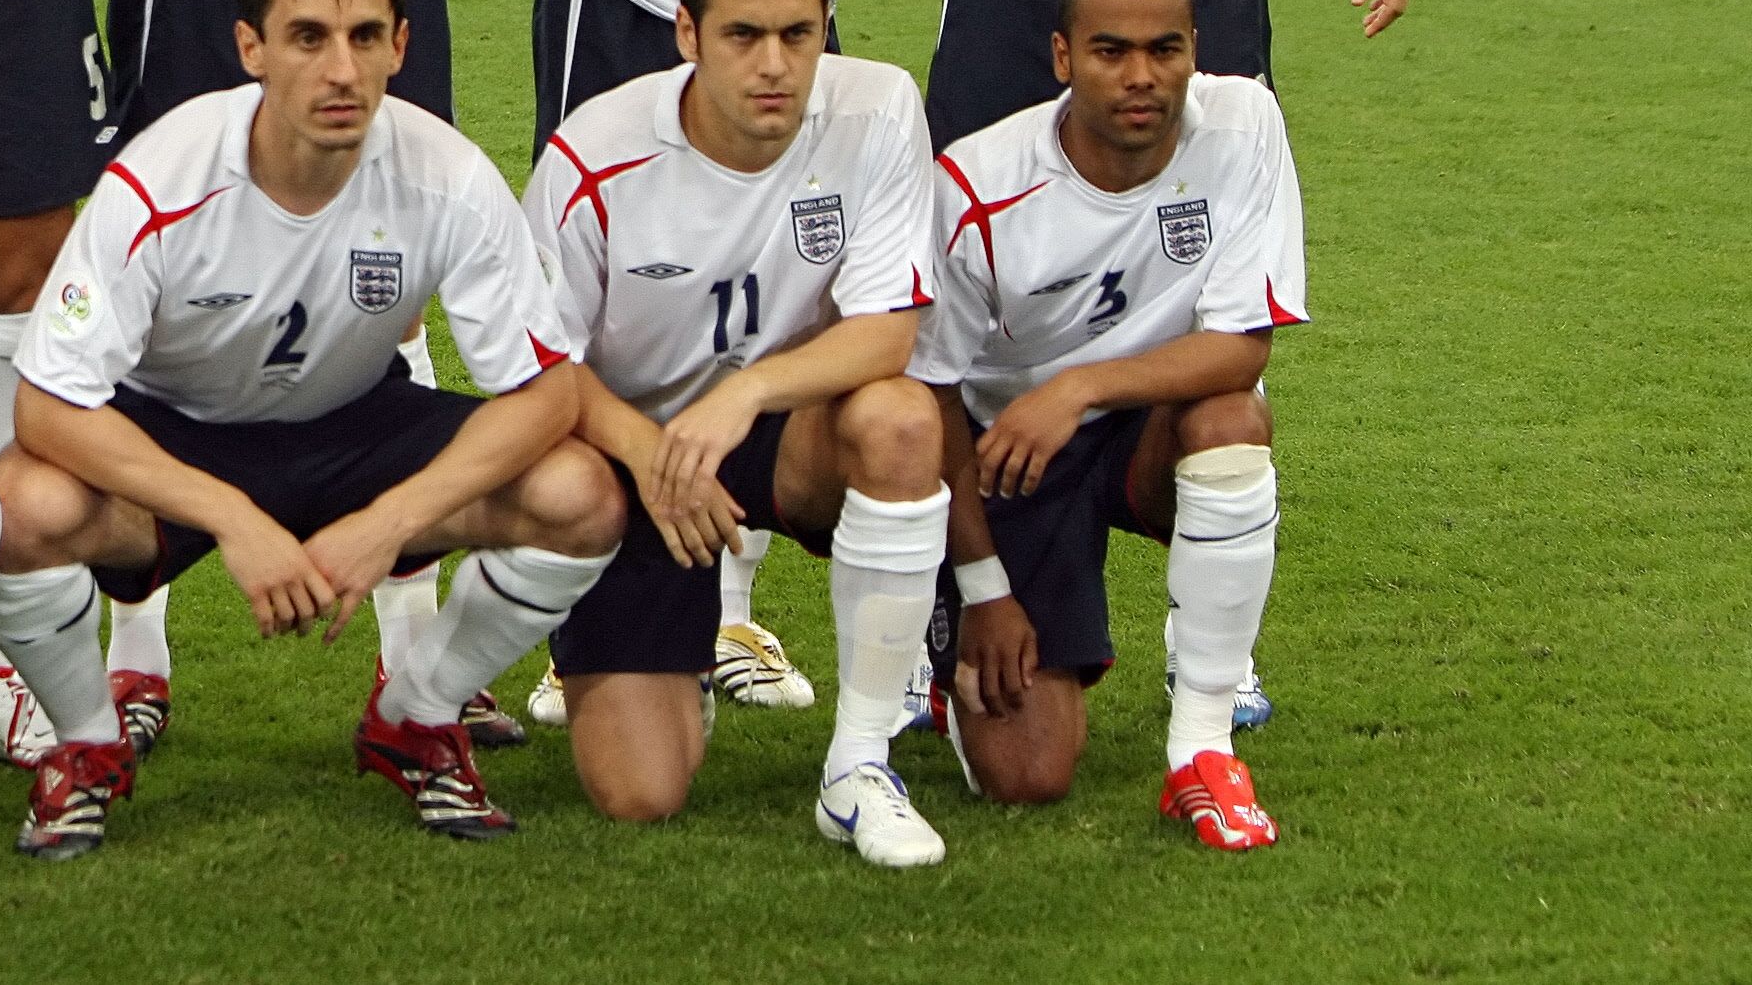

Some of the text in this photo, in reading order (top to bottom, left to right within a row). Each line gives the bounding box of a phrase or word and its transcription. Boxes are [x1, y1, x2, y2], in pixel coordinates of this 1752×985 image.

[82, 33, 107, 121] 5
[709, 273, 760, 354] 11
[1088, 269, 1127, 324] 3
[261, 300, 308, 368] 2
